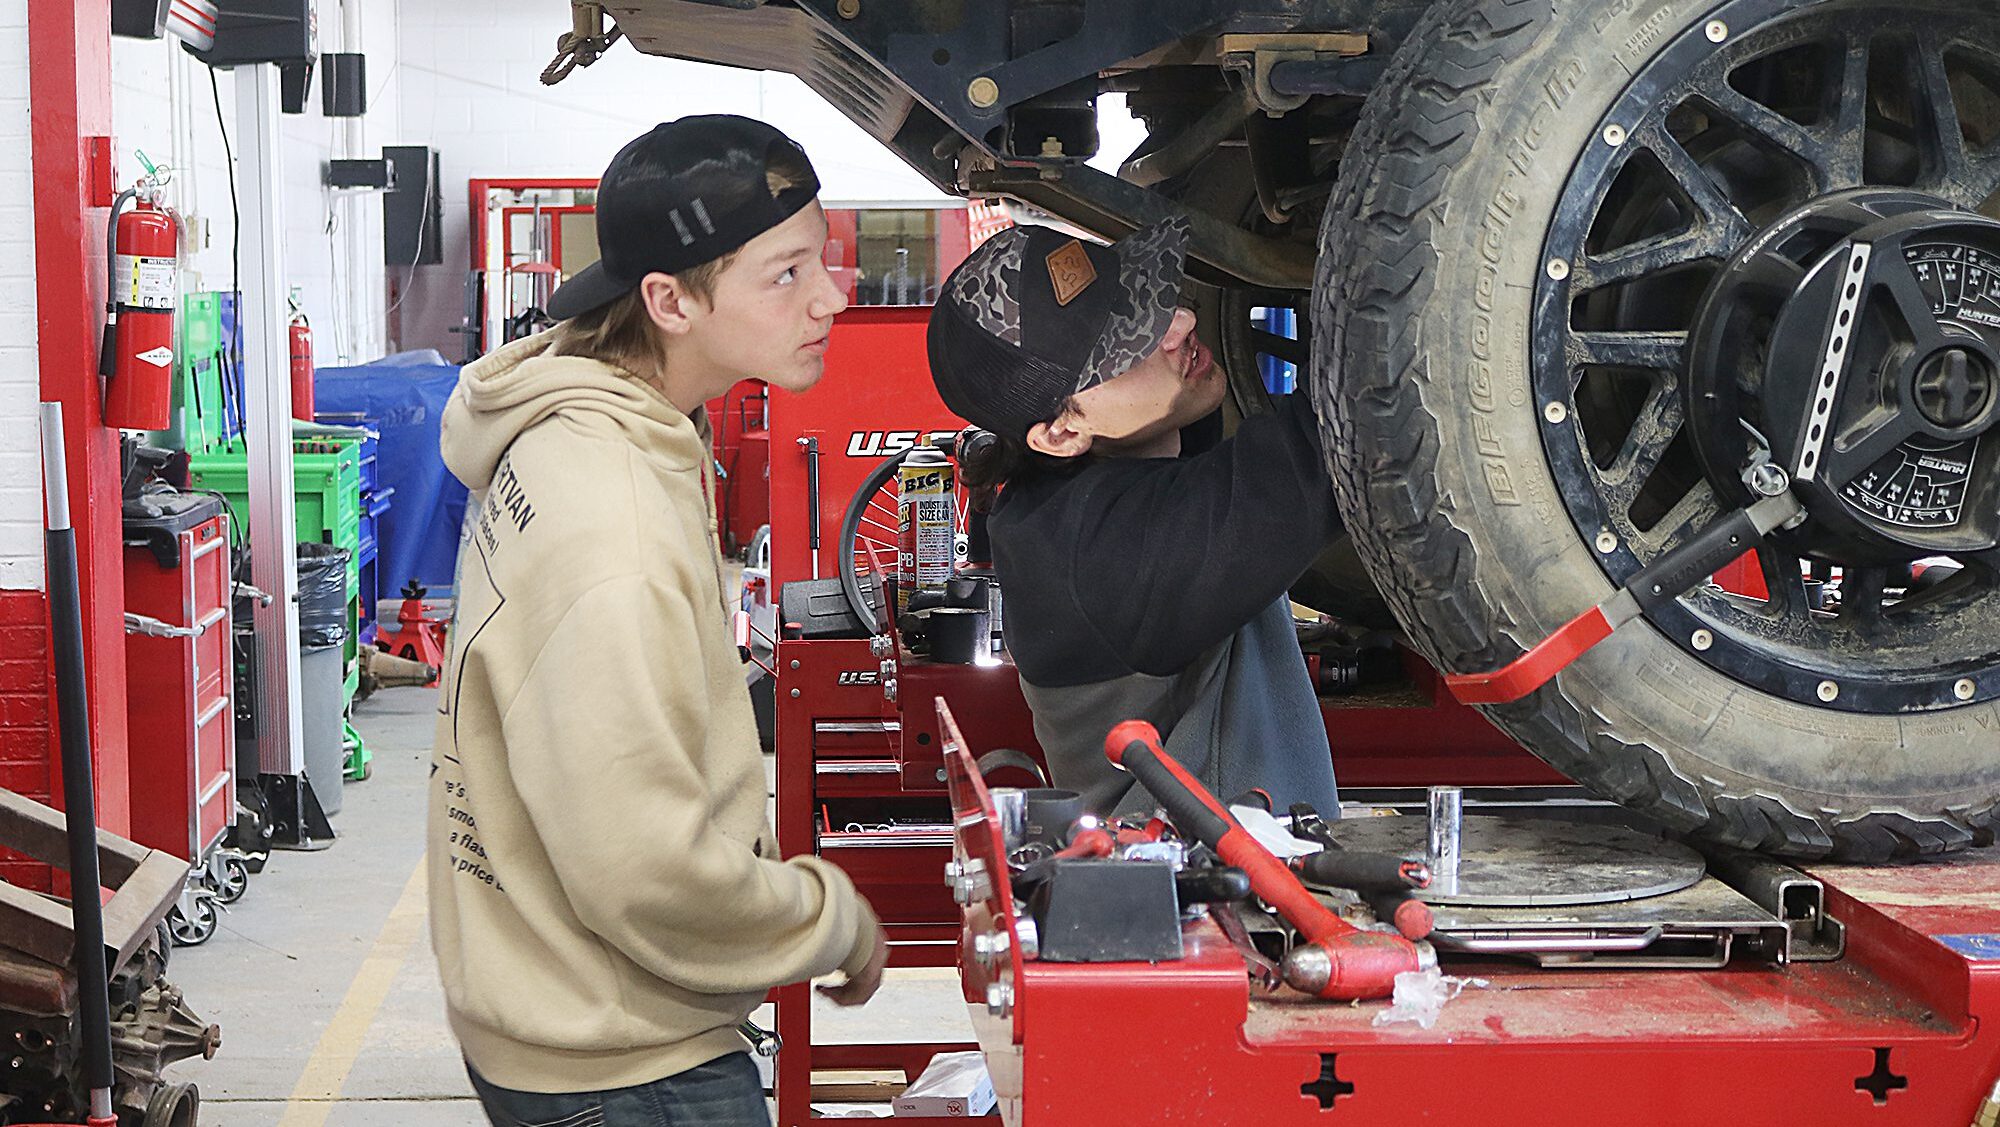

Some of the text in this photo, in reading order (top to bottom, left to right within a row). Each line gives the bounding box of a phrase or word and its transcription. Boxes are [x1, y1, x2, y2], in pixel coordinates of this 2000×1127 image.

[1625, 6, 1671, 49] TUBELESS
[1469, 55, 1587, 507] BFGoodrich
[1918, 457, 1965, 475] HUNTER
[498, 454, 535, 532] RTVAN
[905, 471, 940, 493] BIG
[919, 509, 949, 521] SIZE CAN
[448, 806, 478, 831] smo
[457, 859, 494, 885] price
